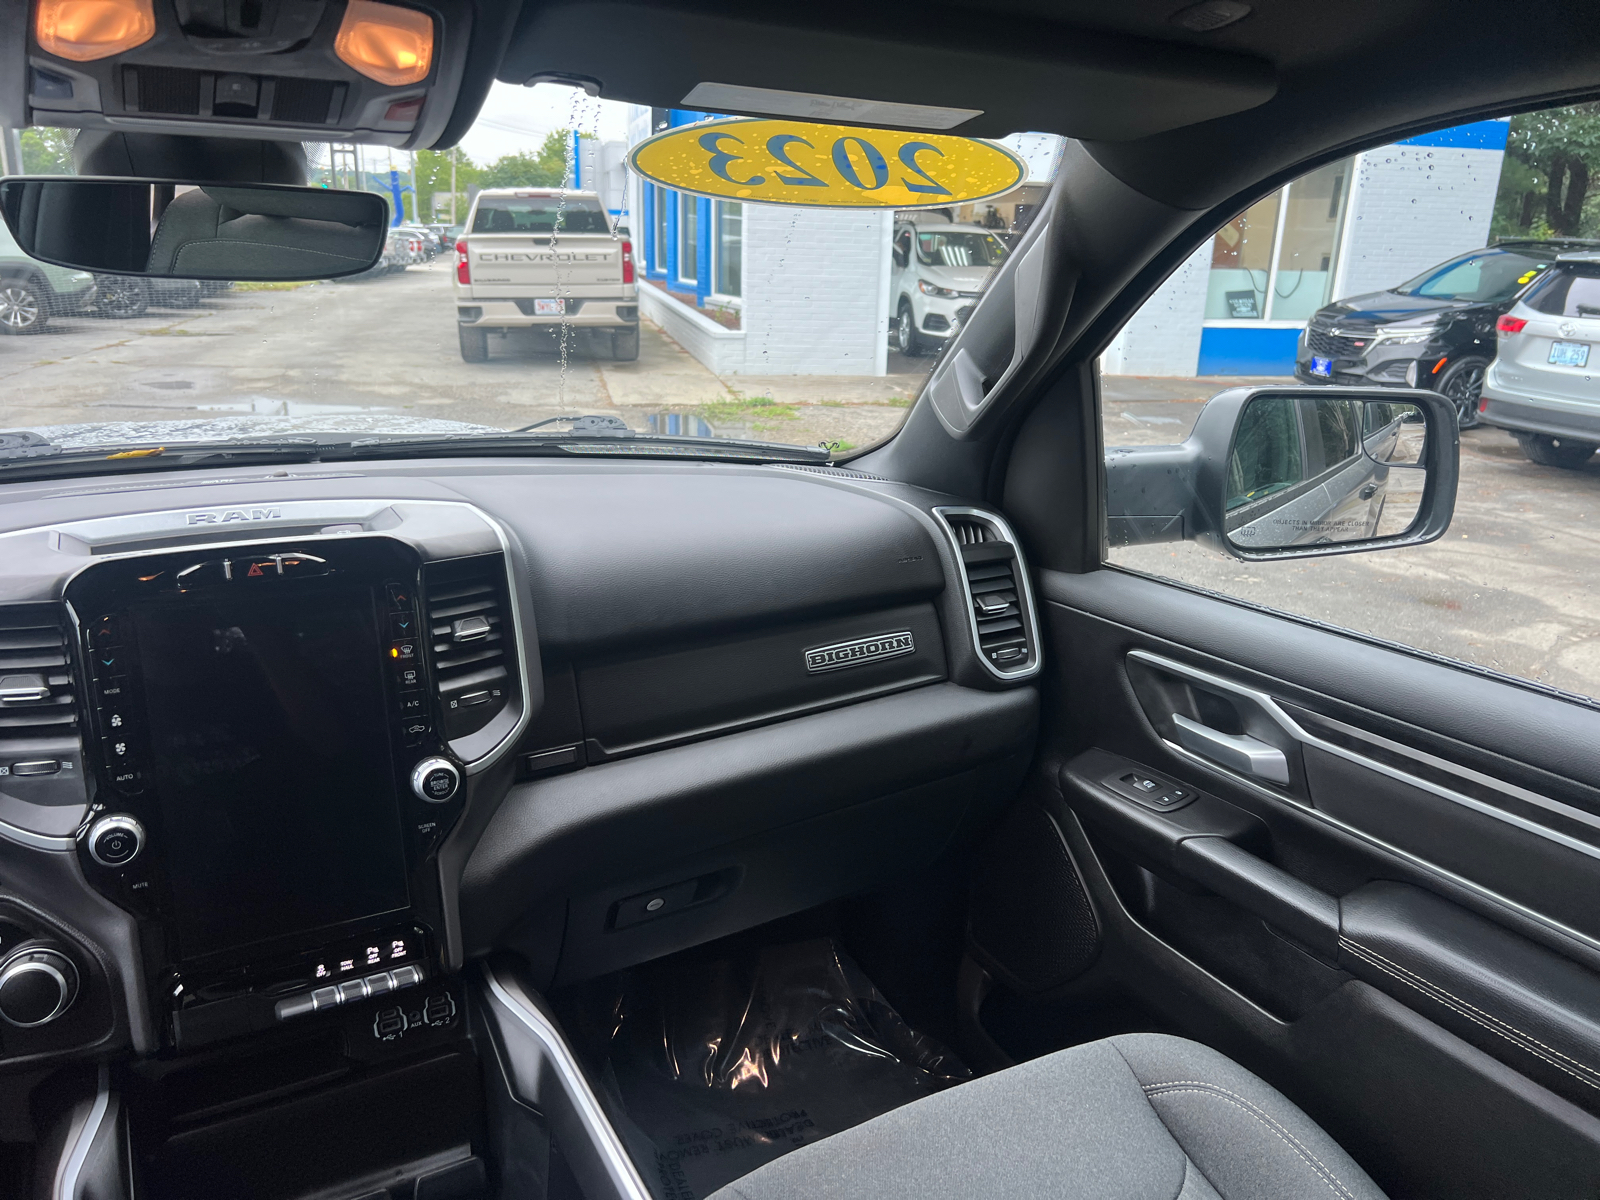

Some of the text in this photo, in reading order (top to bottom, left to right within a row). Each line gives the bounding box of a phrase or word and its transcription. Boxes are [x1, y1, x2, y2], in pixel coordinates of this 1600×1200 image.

[479, 253, 612, 262] CHEVROLET
[187, 507, 281, 525] RAM
[809, 636, 912, 667] BIGHORN
[407, 700, 420, 708] A/C
[116, 773, 134, 781] AUTO
[418, 822, 436, 830] SCREEN
[106, 832, 125, 840] VOLUME
